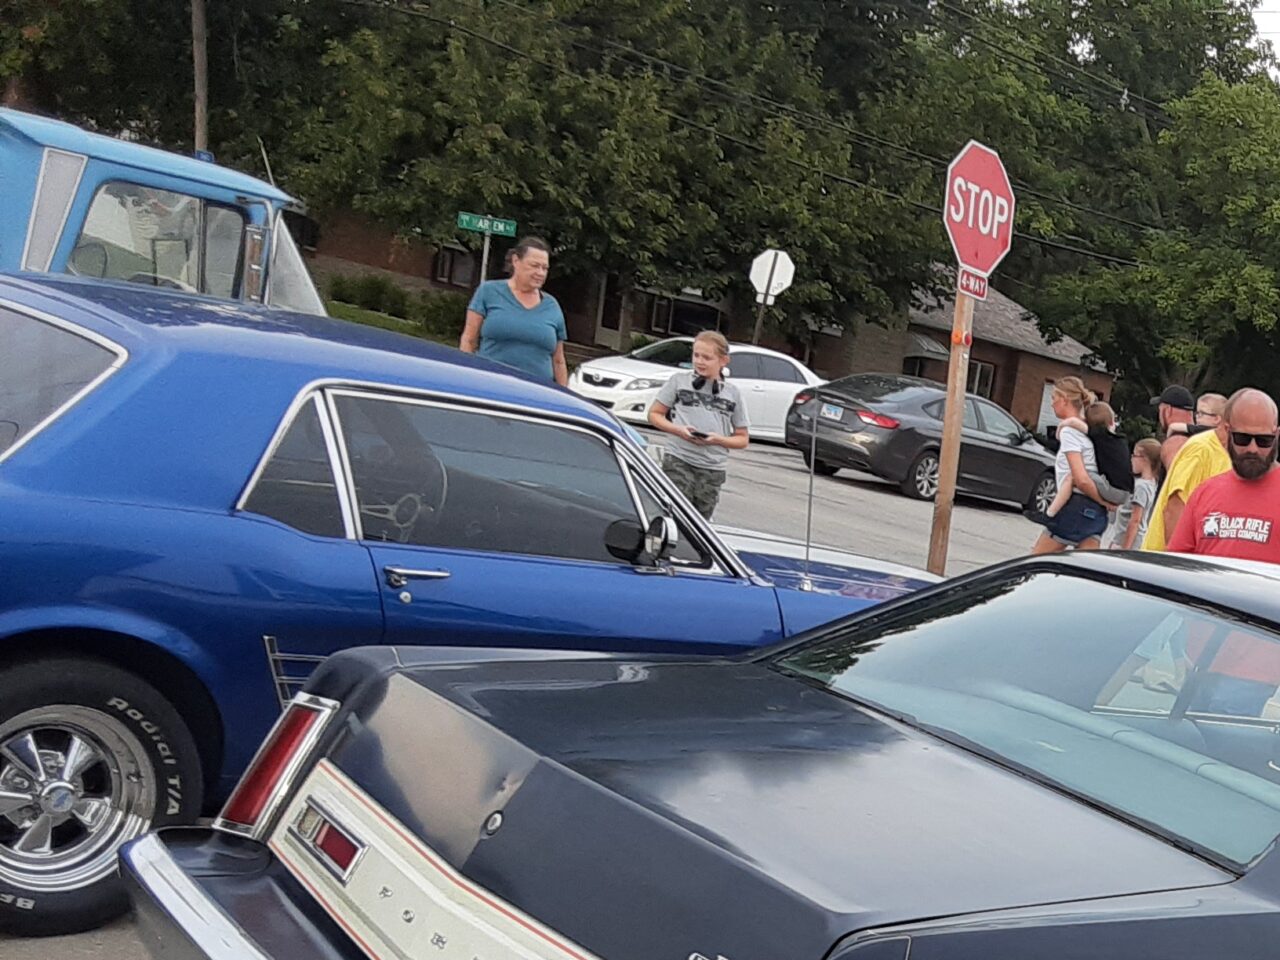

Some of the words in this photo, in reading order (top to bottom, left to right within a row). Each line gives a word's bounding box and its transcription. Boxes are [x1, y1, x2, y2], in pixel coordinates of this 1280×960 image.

[950, 176, 1009, 239] STOP
[961, 274, 985, 295] 4-WAY
[1221, 516, 1245, 530] BLACK
[1245, 517, 1271, 534] RIFLE
[1237, 529, 1269, 543] COMPANY
[107, 697, 177, 765] Radial
[166, 775, 182, 814] T/A
